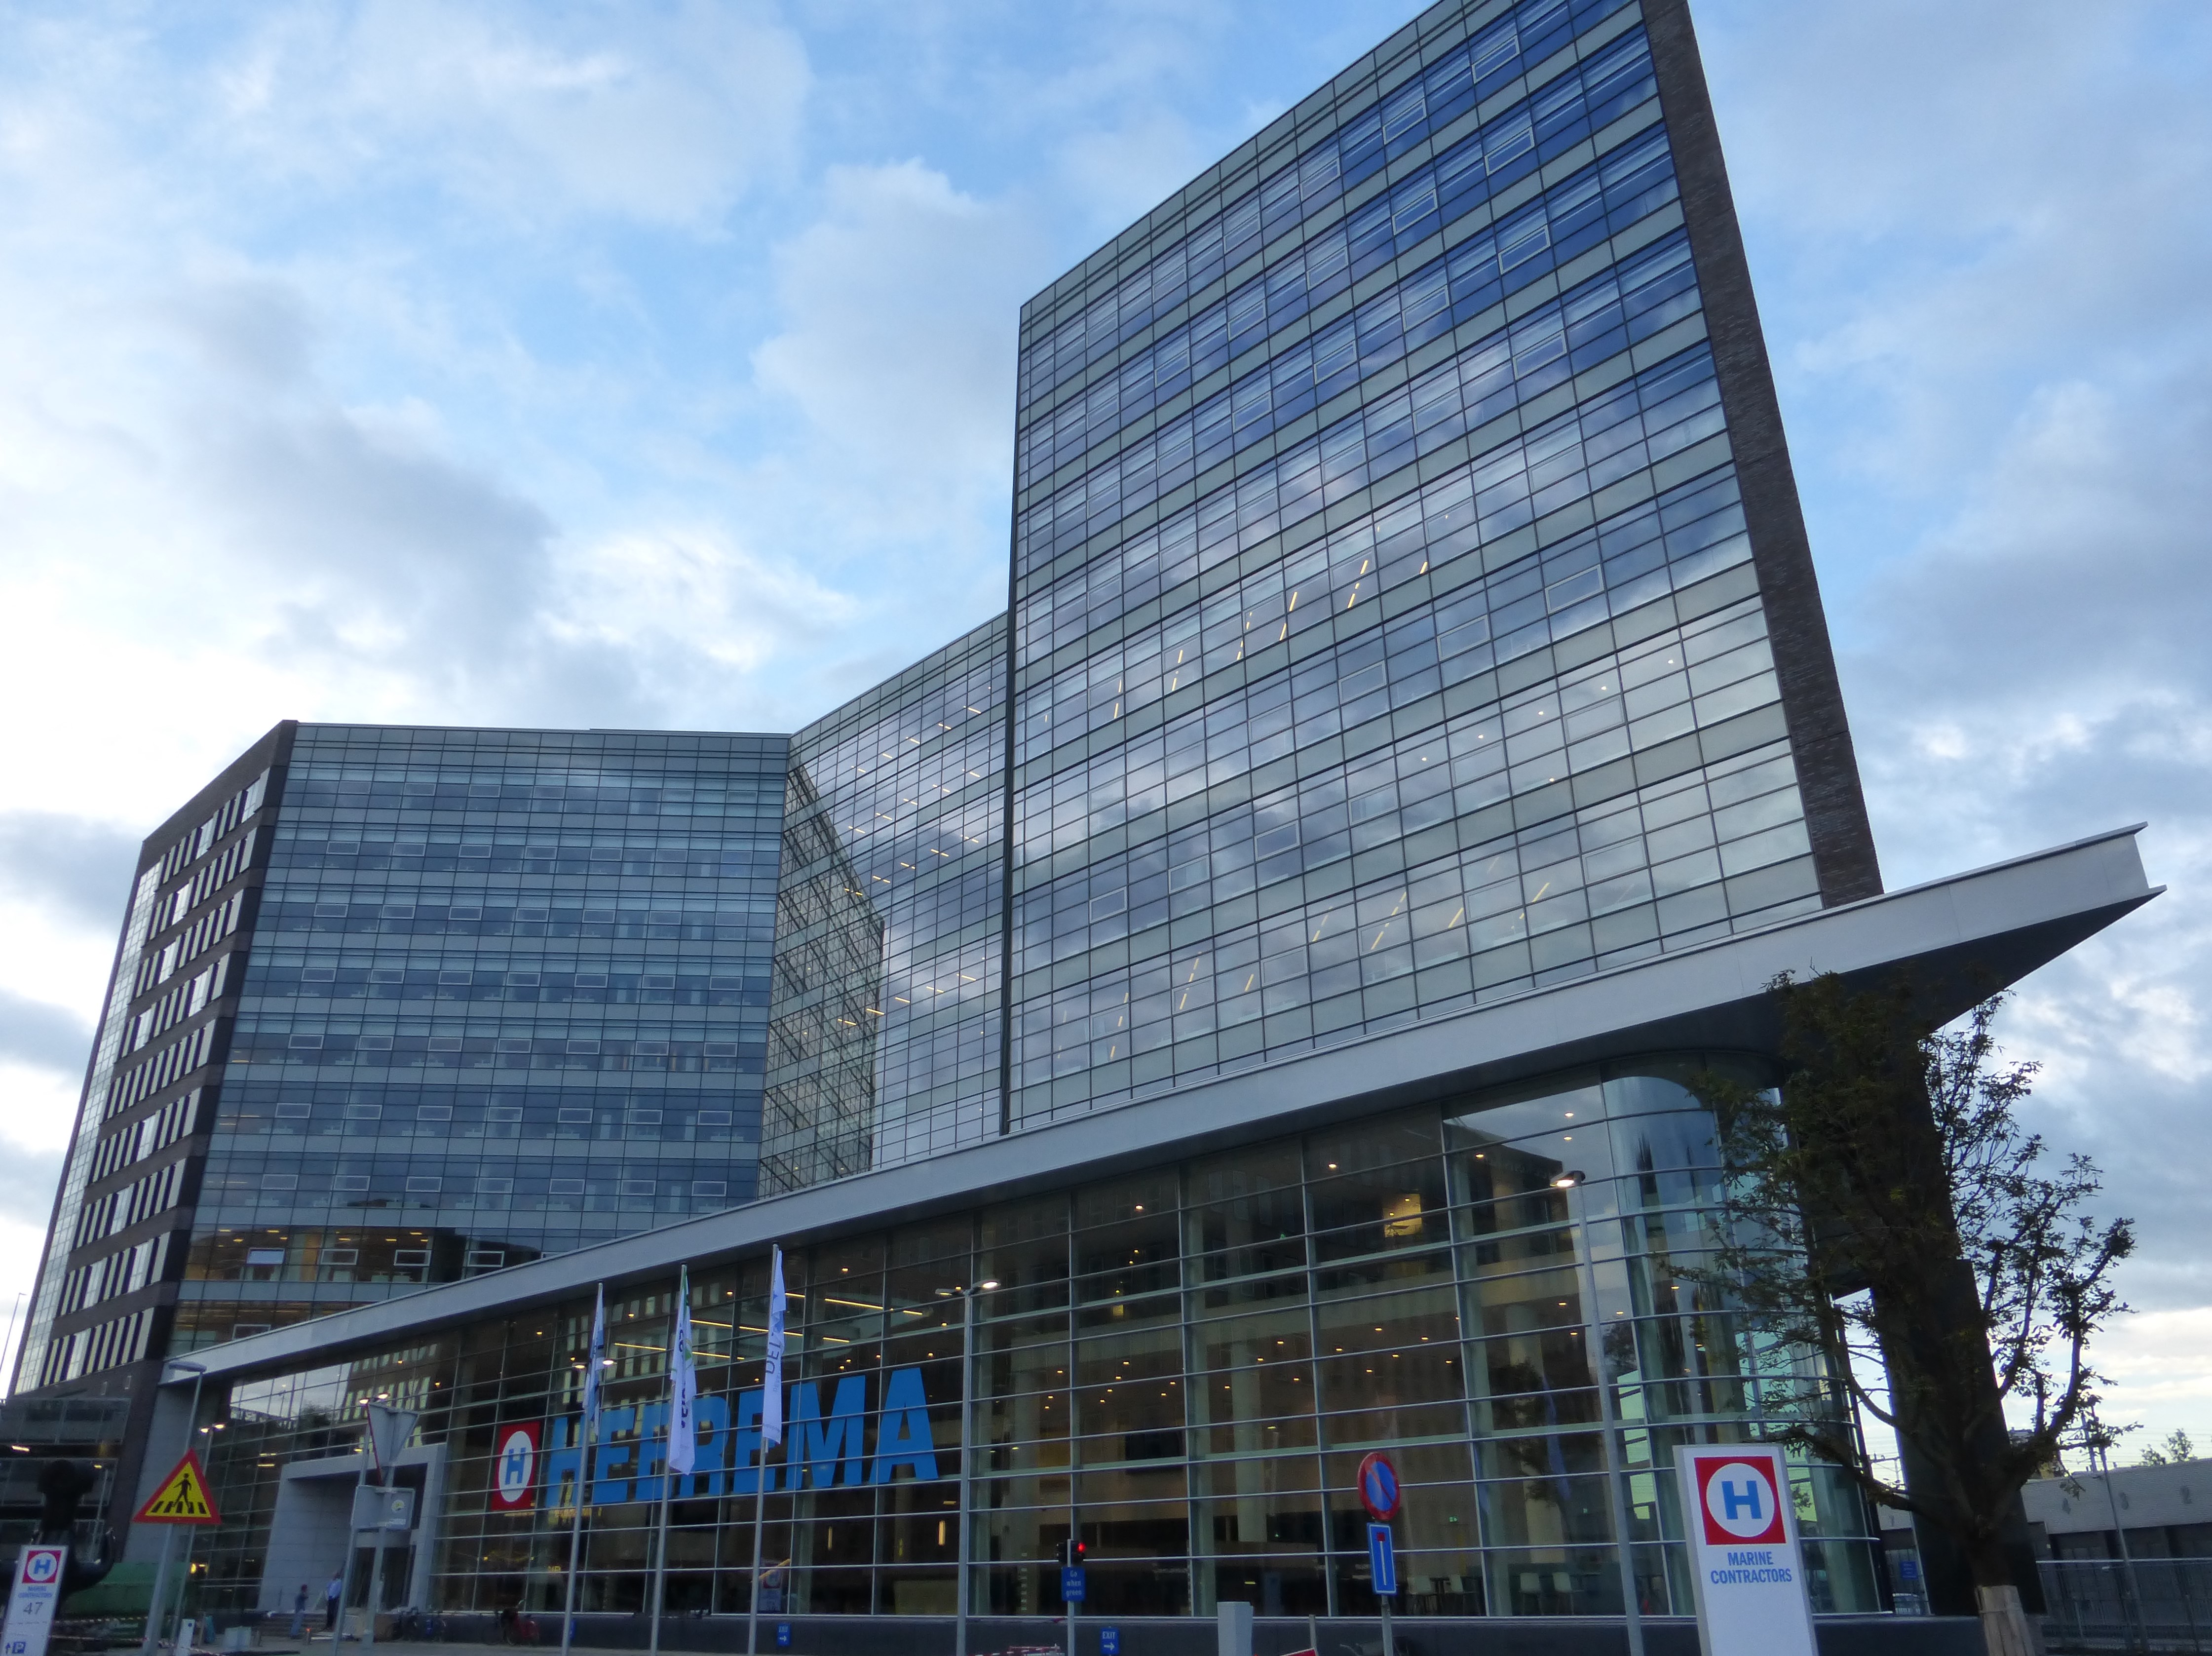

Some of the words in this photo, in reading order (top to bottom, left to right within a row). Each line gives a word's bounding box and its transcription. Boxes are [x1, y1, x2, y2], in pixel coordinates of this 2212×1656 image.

[504, 1447, 526, 1485] H
[1721, 1480, 1763, 1520] H
[1727, 1551, 1774, 1566] MARINE
[34, 1559, 51, 1574] H
[1710, 1568, 1792, 1584] CONTRACTORS
[24, 1602, 43, 1615] 47
[1102, 1631, 1116, 1639] EXIT
